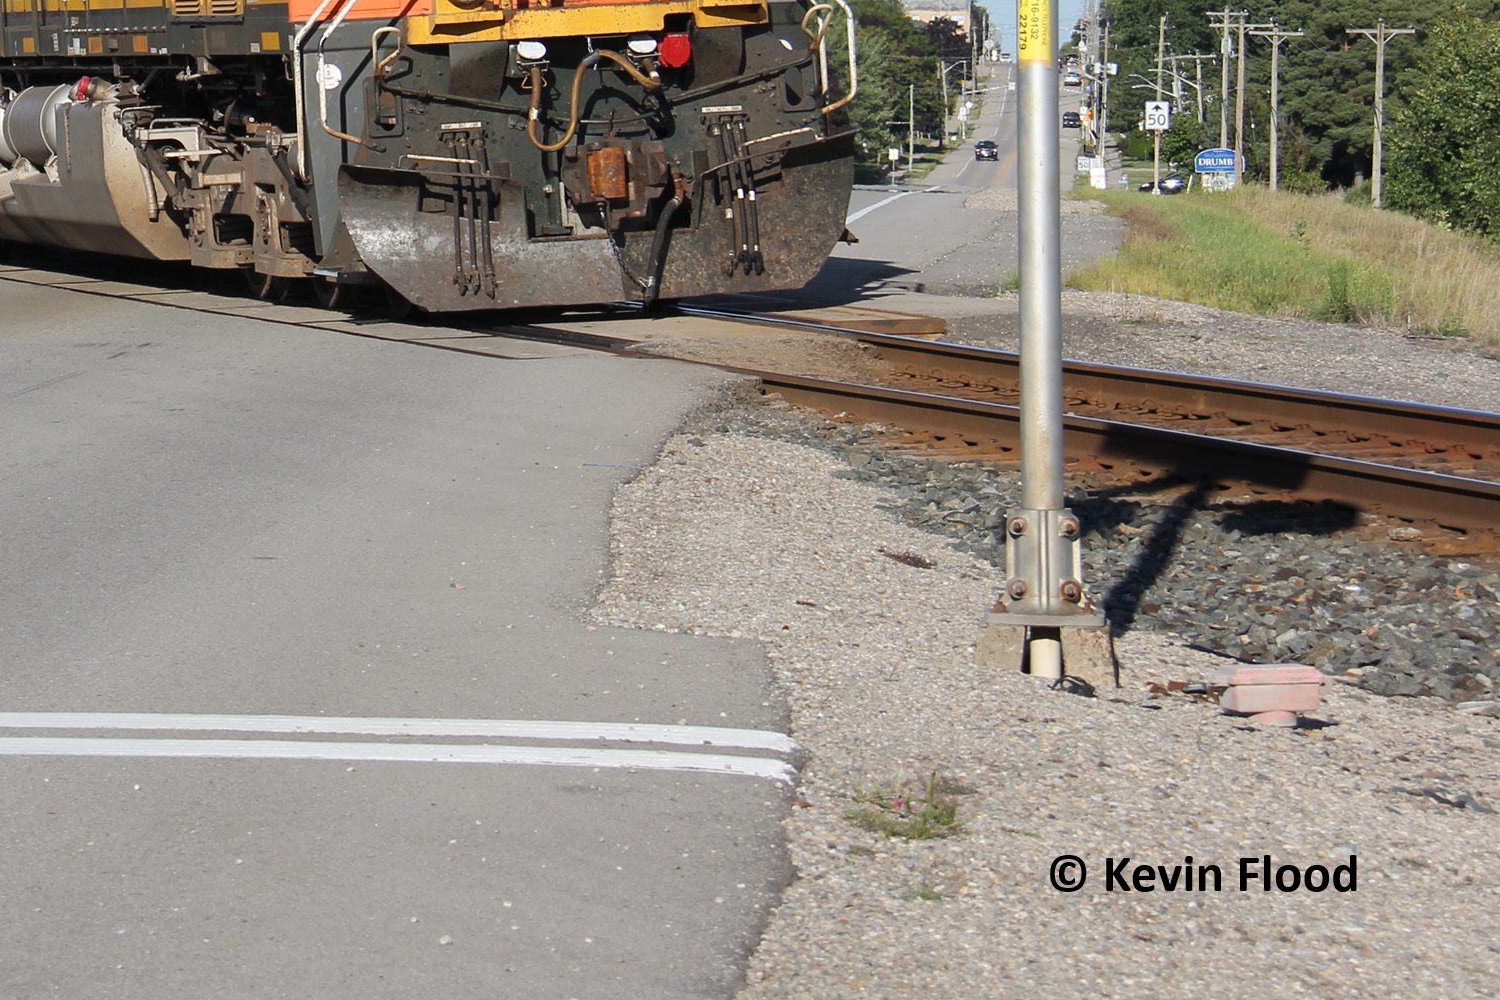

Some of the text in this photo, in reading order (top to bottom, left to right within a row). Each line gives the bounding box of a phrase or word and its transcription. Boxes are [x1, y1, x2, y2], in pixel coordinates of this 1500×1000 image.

[1019, 14, 1028, 51] 22179
[1148, 113, 1166, 126] 50
[1079, 161, 1089, 169] 50
[1198, 158, 1236, 166] DRUMB
